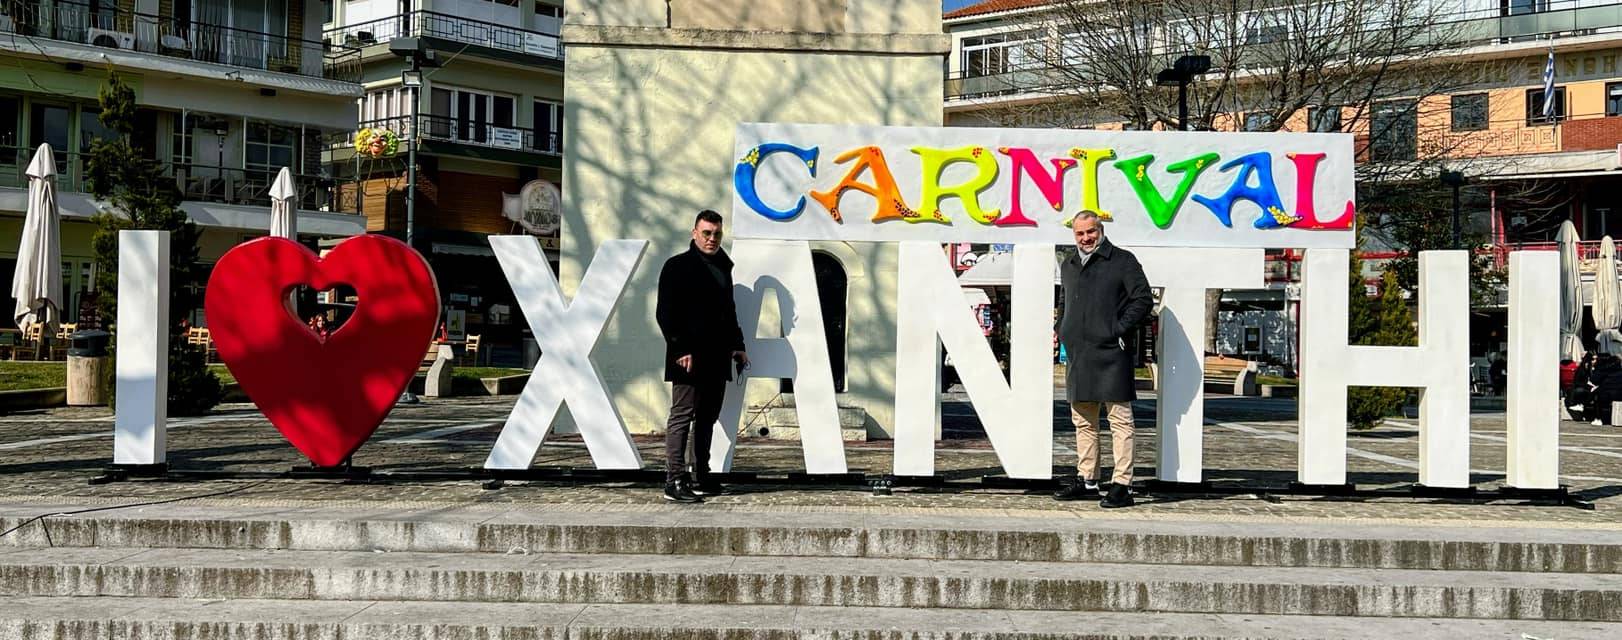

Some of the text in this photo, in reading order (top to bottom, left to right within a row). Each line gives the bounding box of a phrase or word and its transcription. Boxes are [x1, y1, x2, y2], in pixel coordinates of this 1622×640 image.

[734, 142, 1356, 232] CARNIVAL
[114, 230, 170, 464] I
[484, 234, 1560, 490] XANTHI
